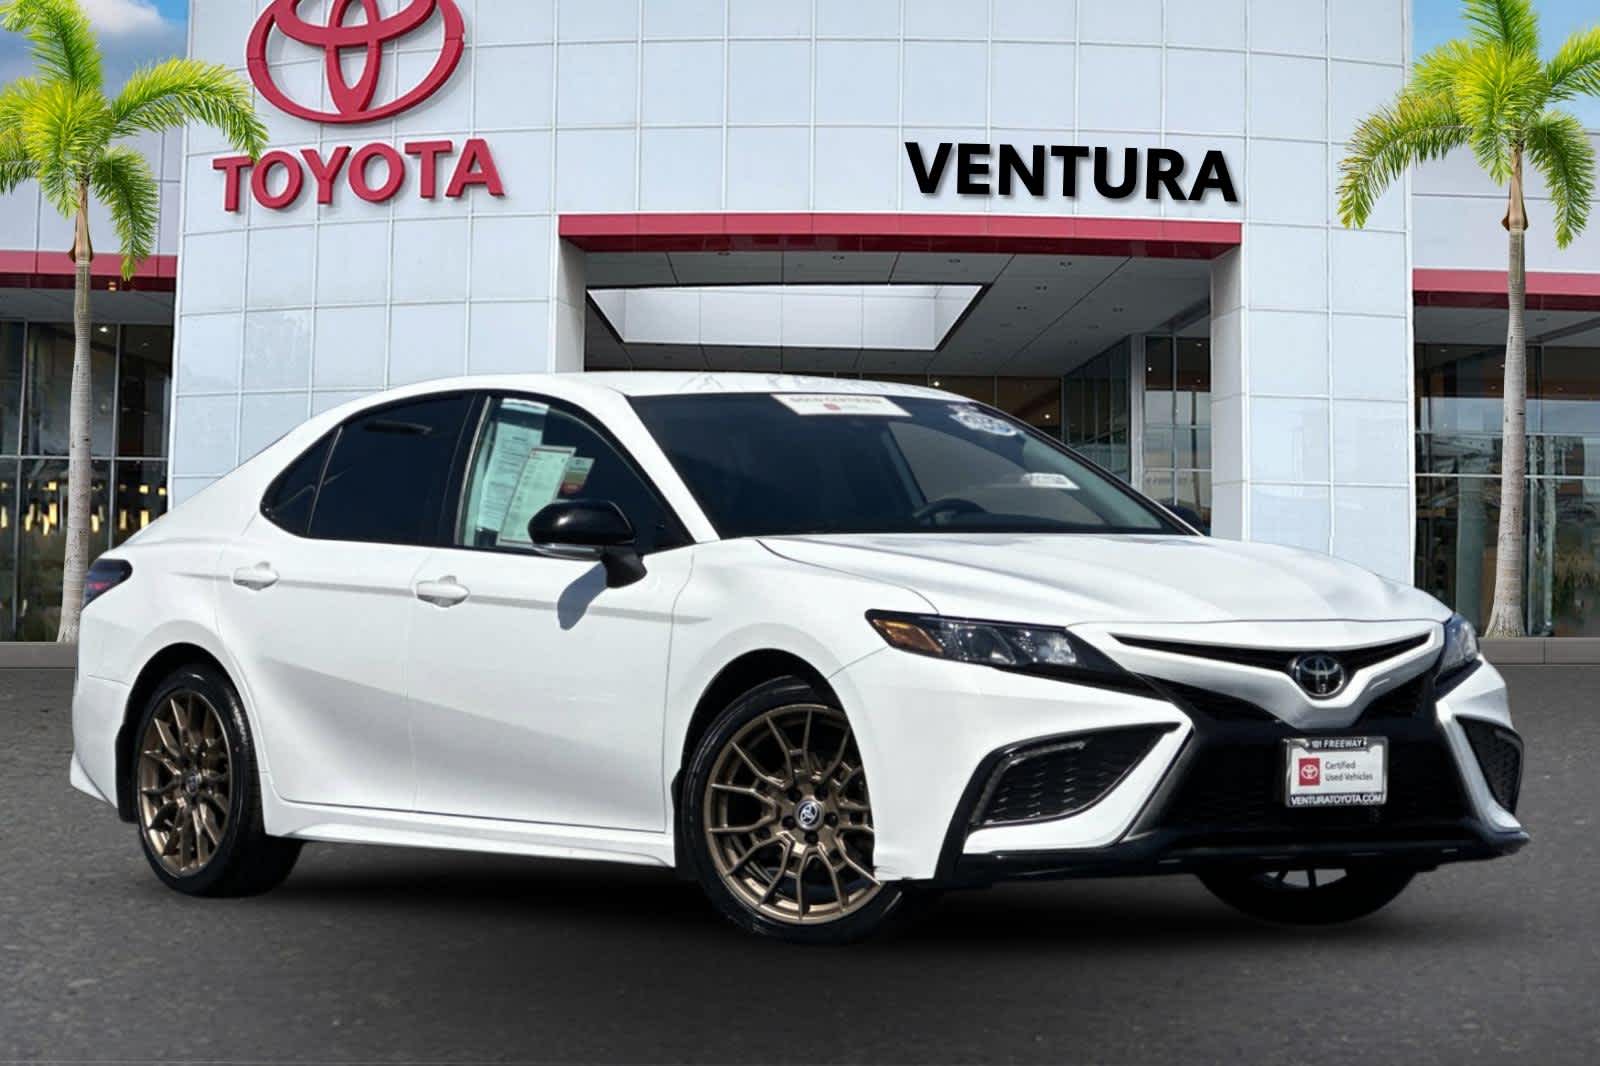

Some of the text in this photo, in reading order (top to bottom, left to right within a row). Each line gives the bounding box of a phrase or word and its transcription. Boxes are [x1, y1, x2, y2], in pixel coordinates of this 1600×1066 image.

[213, 138, 505, 212] TOYOTA
[905, 142, 1238, 203] VENTURA
[1323, 739, 1362, 748] FREEWAY
[1325, 760, 1356, 770] Certified
[1325, 771, 1373, 781] Used Vehicles
[1291, 794, 1381, 805] VENTURATOYOTA.COM
